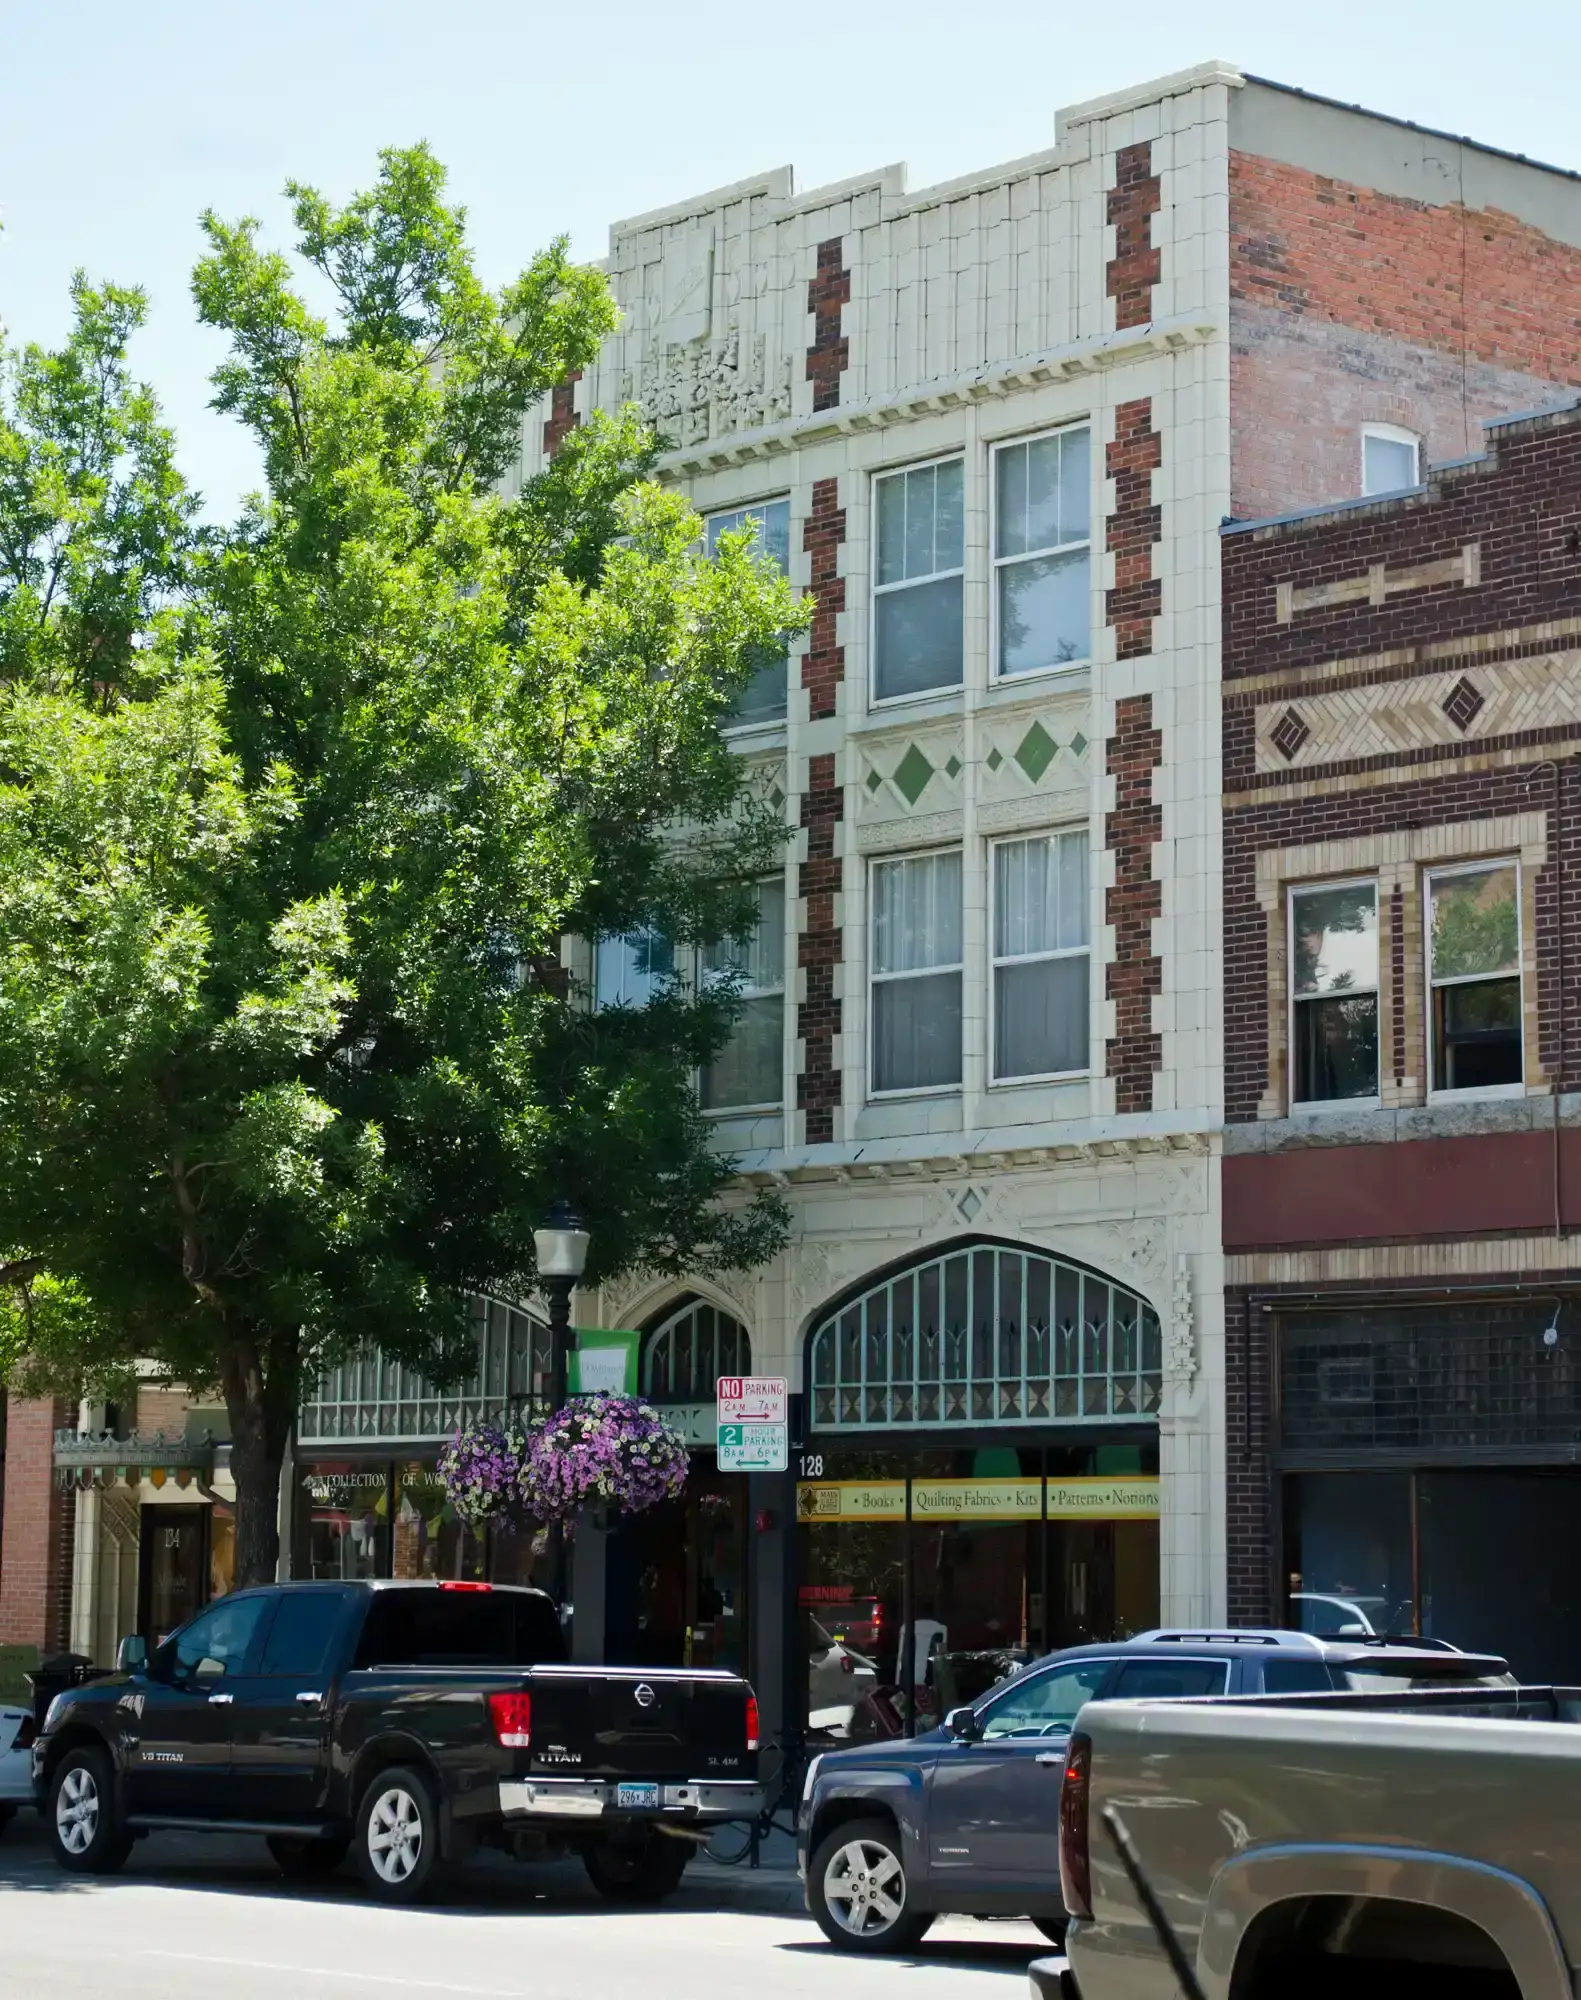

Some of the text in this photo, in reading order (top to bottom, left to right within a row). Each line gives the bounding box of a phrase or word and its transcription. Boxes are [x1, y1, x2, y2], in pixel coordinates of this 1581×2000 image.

[721, 1379, 783, 1398] NO PARKING
[724, 1427, 737, 1444] 2
[750, 1427, 776, 1435] HOUR
[744, 1436, 784, 1446] PARKING
[799, 1455, 823, 1476] 128
[327, 1473, 387, 1487] COLLECTION
[402, 1473, 416, 1487] OF
[863, 1492, 895, 1508] Books
[916, 1490, 1002, 1511] Quilting Fabrics
[1015, 1490, 1038, 1507] Kits
[1058, 1489, 1104, 1506] Patterns
[1112, 1489, 1159, 1506] Notions
[165, 1528, 180, 1548] 134
[142, 1752, 184, 1762] V8 TITAN
[538, 1752, 582, 1763] TITAN
